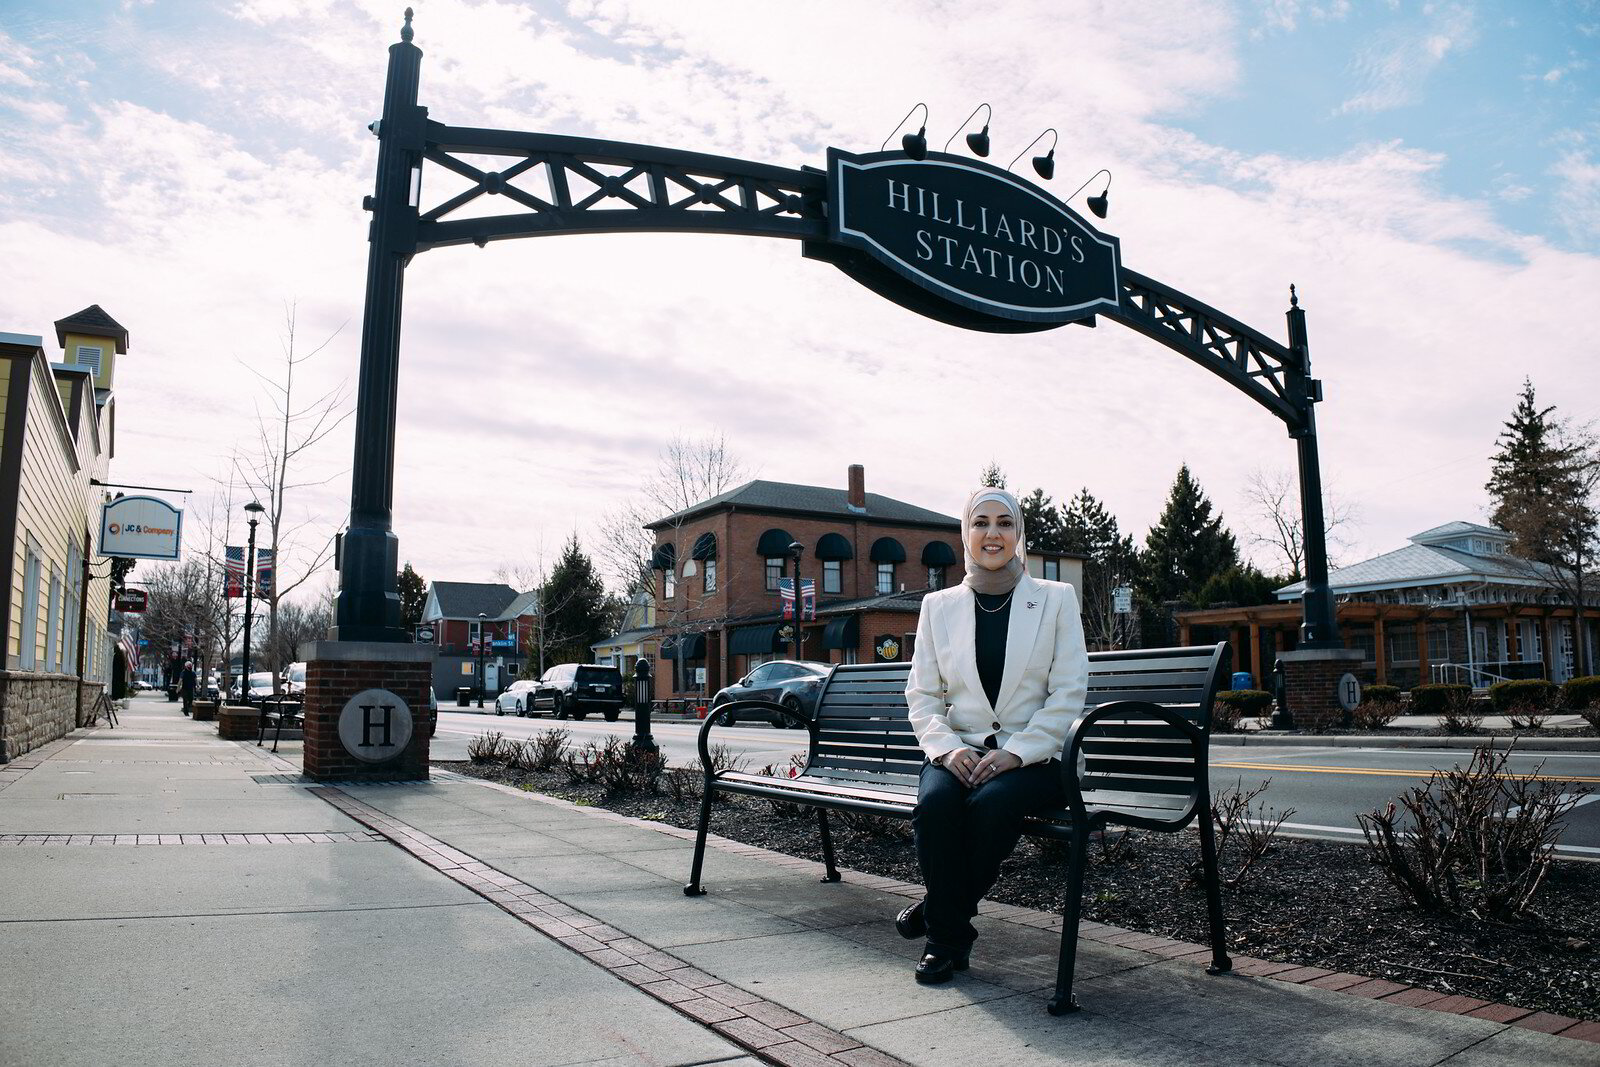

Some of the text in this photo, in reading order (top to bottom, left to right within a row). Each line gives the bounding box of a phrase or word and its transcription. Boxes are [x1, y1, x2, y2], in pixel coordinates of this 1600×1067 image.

[887, 178, 1085, 263] HILLIARD'S
[916, 229, 1065, 296] STATION
[136, 525, 142, 533] &
[143, 525, 173, 536] Company
[1346, 681, 1358, 704] H
[358, 705, 396, 747] H
